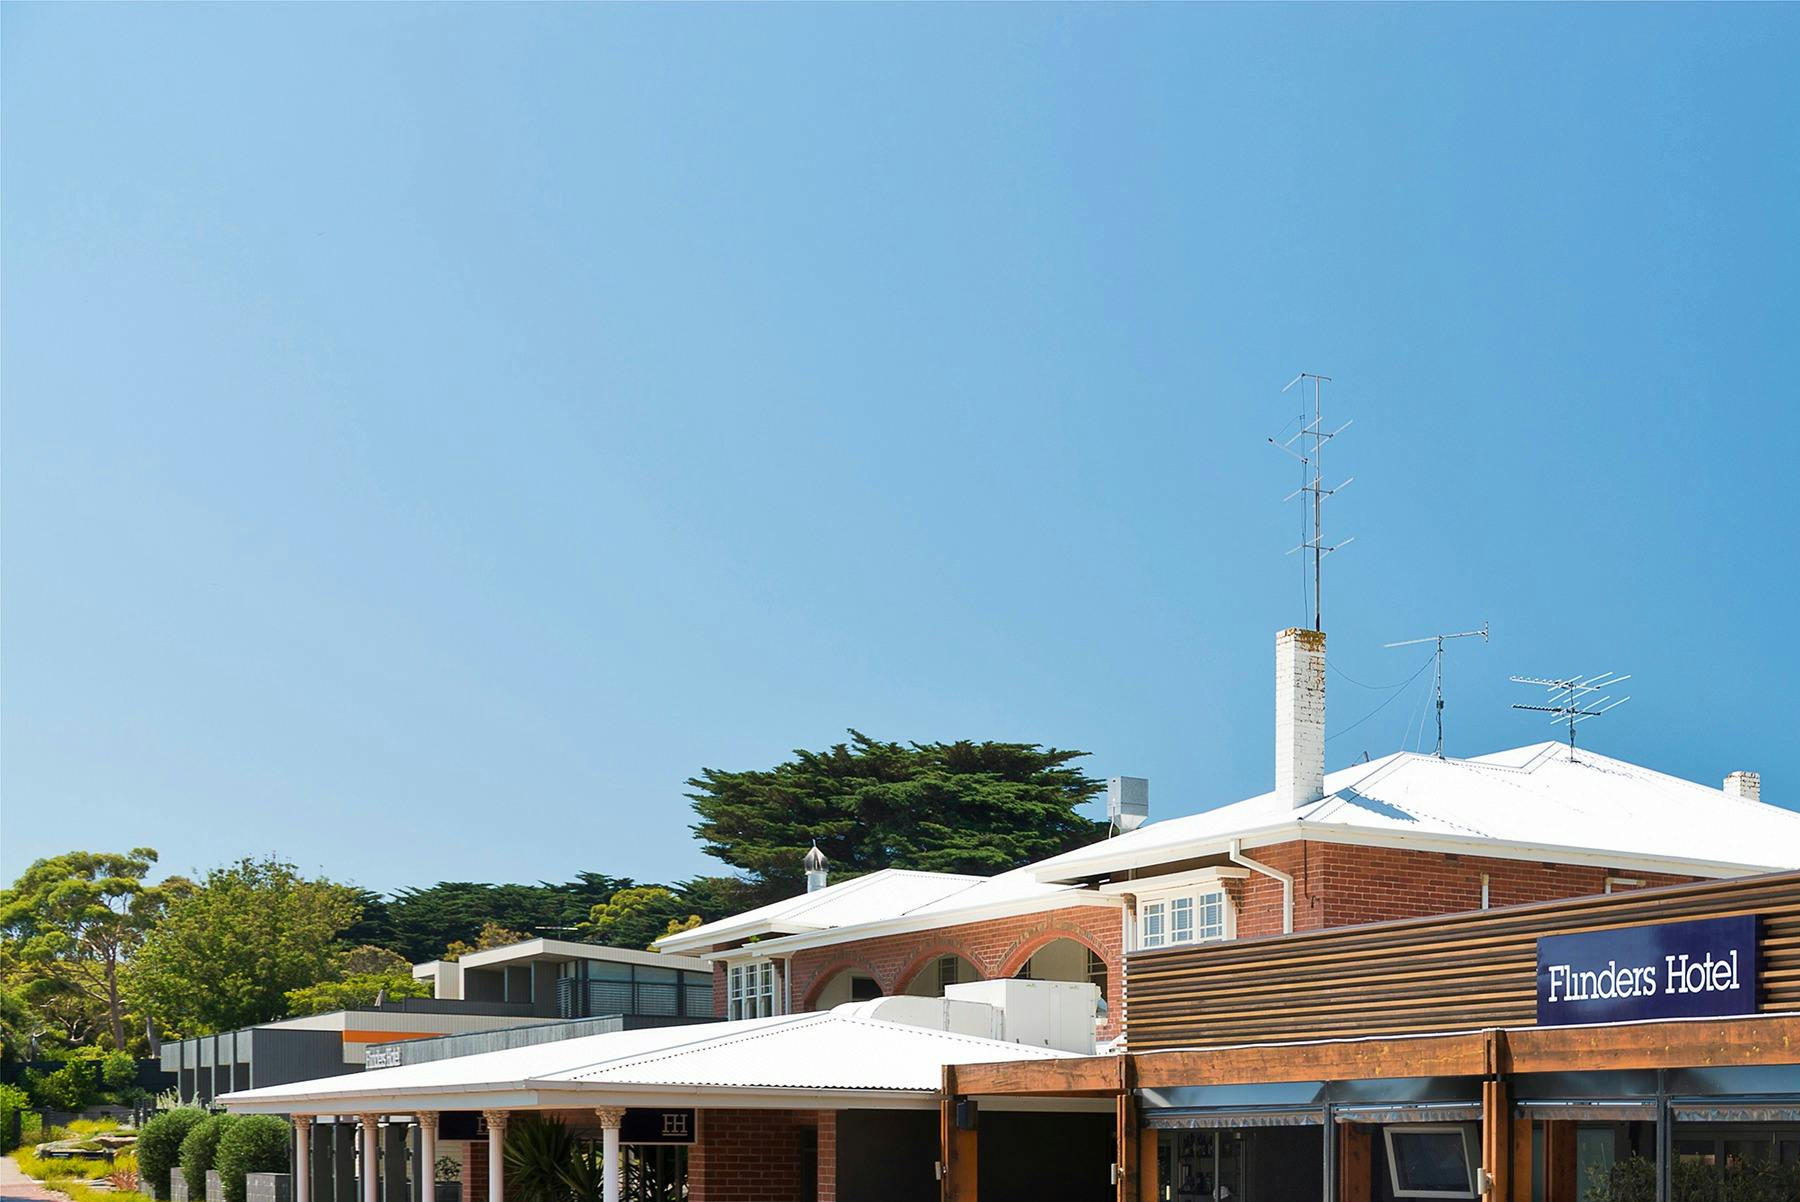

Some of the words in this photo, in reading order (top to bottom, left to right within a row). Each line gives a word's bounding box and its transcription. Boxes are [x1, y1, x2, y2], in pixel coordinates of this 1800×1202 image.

[1548, 961, 1657, 1003] Flinders
[1665, 949, 1740, 994] Hotel
[662, 1113, 688, 1133] FH
